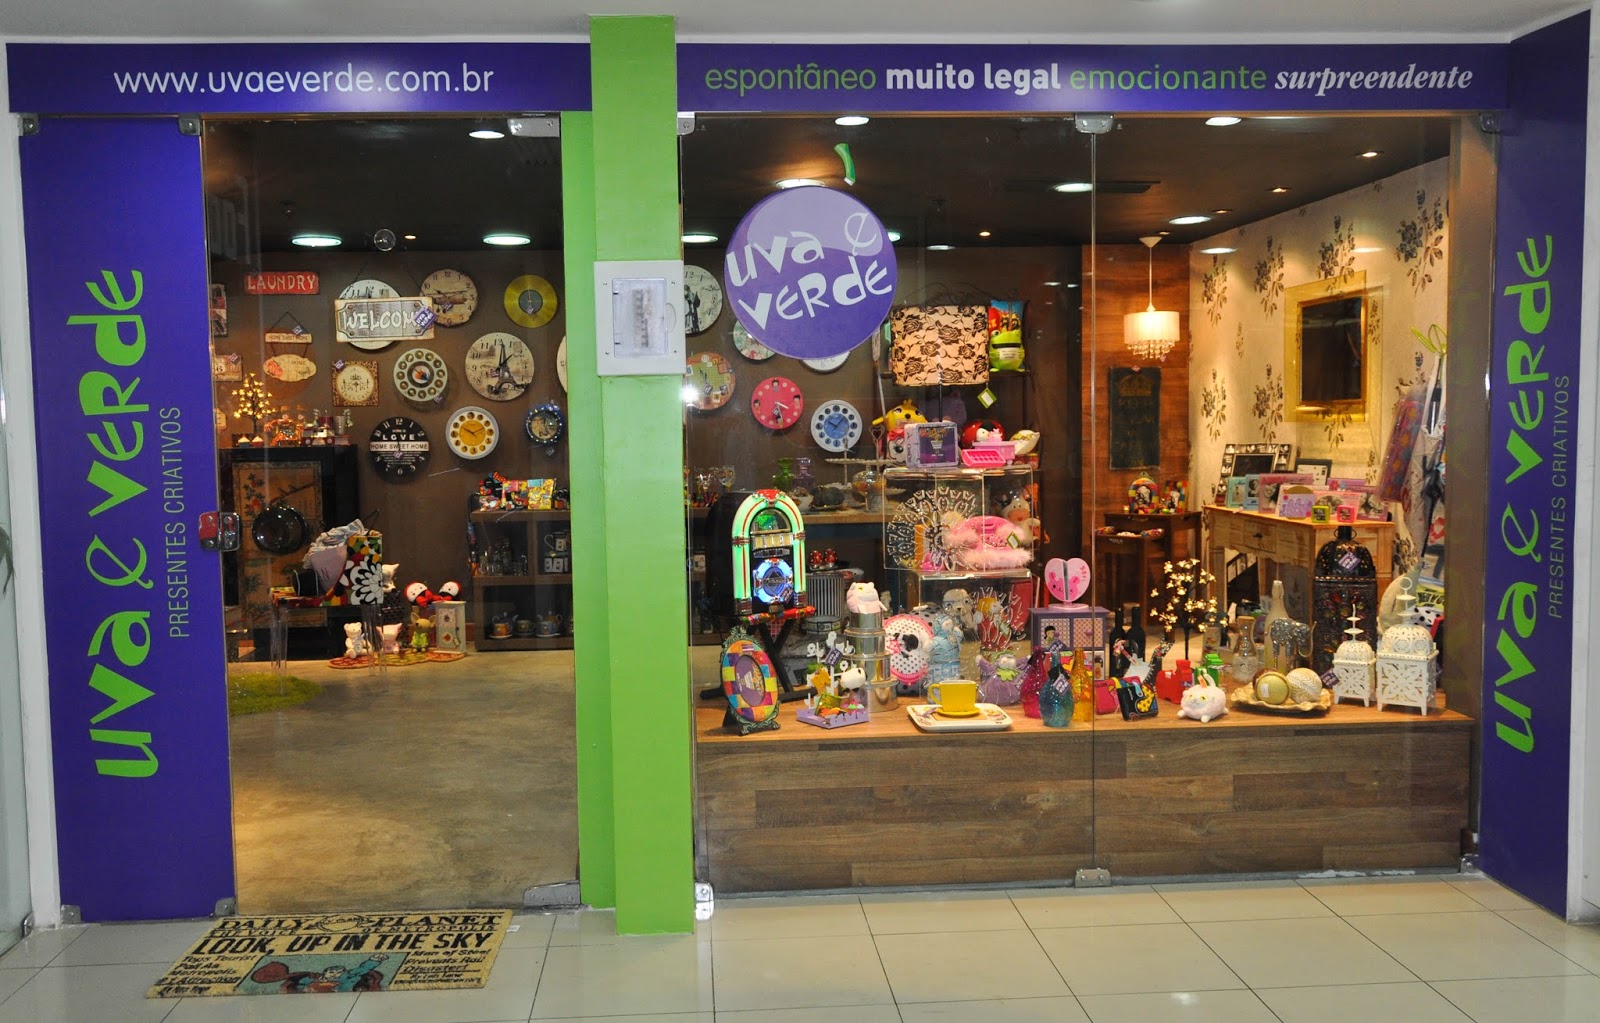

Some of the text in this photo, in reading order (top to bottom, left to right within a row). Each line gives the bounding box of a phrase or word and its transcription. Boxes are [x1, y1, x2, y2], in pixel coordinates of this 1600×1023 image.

[114, 63, 494, 93] www.uvaeverde.com.br
[705, 63, 1473, 97] espontâneo muito legal emocionante surpreendente
[247, 275, 316, 291] LAUNDRY
[343, 309, 419, 331] WELCOM
[382, 433, 415, 441] LOVE
[1549, 375, 1570, 618] PRESENTES CRIATIVOS
[160, 407, 189, 638] PRESENTES CRIATIVOS
[217, 918, 305, 930] DAILY
[374, 914, 503, 927] PLANET
[190, 932, 494, 955] LOOK, UP IN THE SKY
